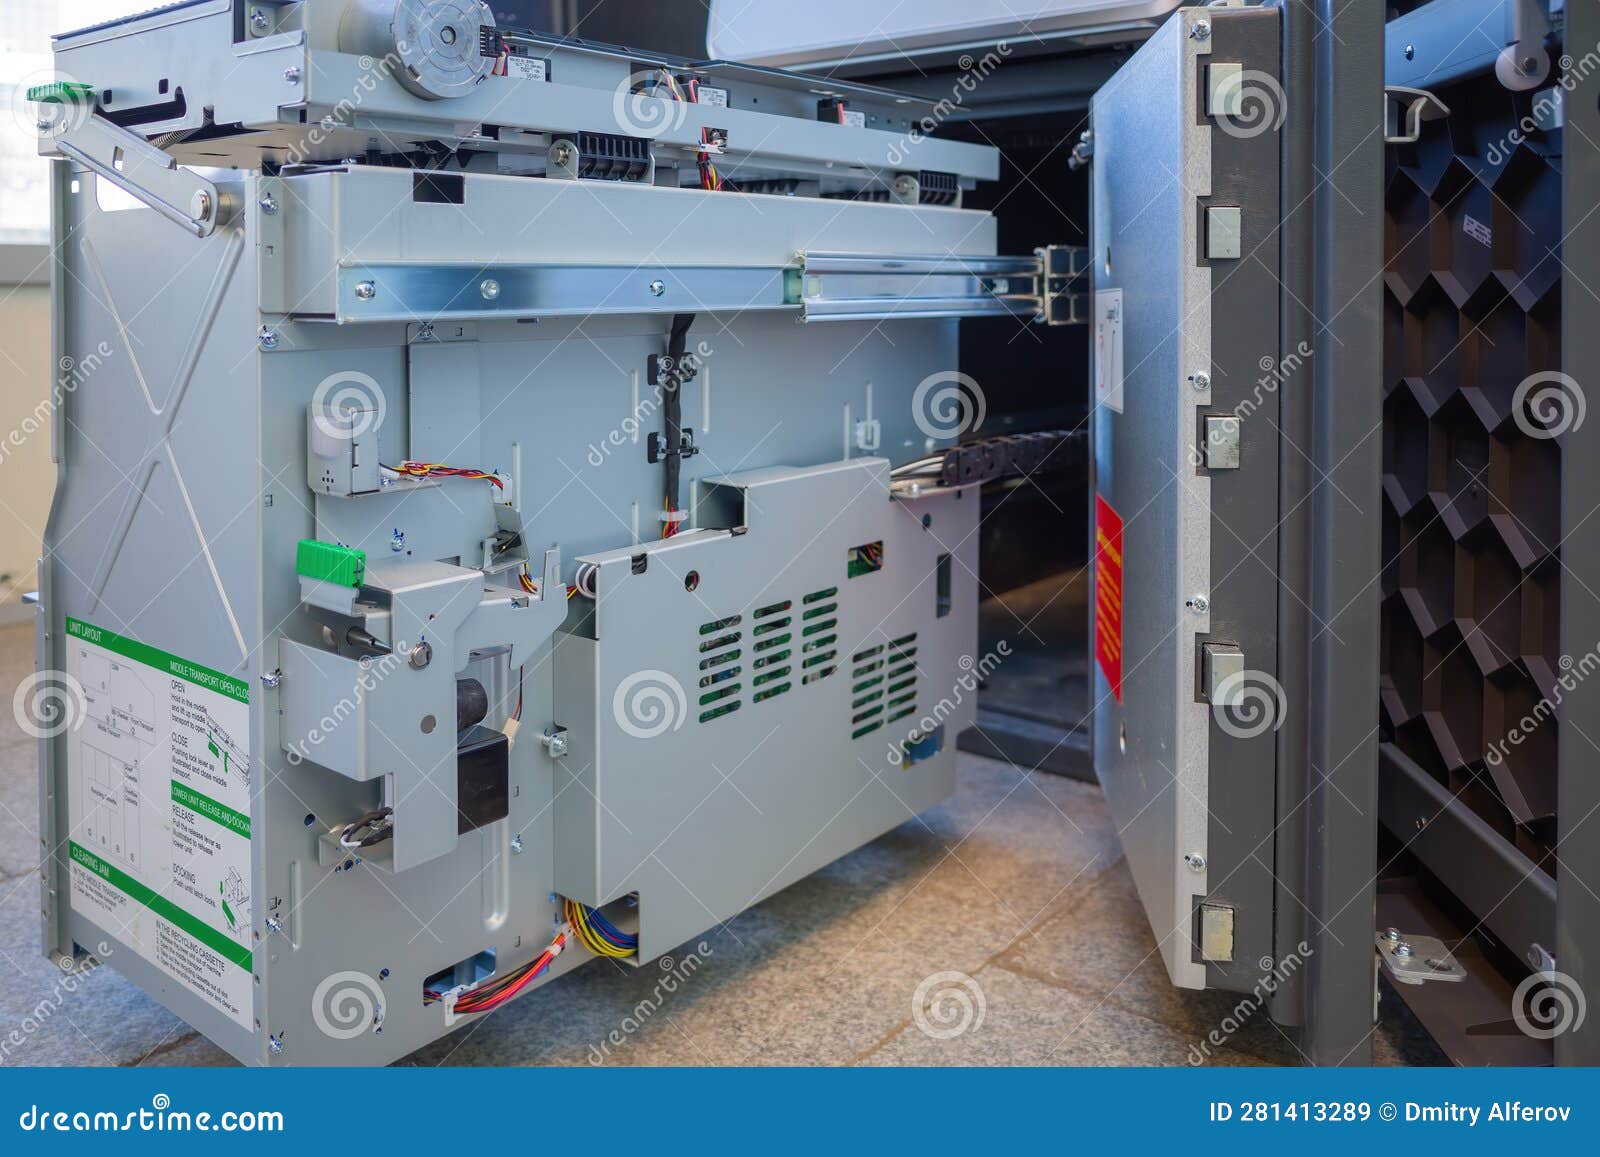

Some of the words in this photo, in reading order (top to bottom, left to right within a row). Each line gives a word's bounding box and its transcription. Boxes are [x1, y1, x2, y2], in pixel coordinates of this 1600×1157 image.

[69, 620, 80, 635] UNIT
[81, 624, 101, 642] LAYOUT
[170, 660, 188, 677] MIDDLE
[189, 667, 218, 688] TRANSPORT
[219, 678, 234, 694] OPEN
[171, 679, 184, 693] OPEN
[171, 730, 187, 748] CLOSE
[172, 804, 194, 825] RELEASE
[199, 798, 221, 819] RELEASE
[221, 809, 232, 825] AND
[72, 845, 98, 872] CLEARING
[99, 861, 109, 879] JAM
[173, 862, 195, 885] DOCKING
[171, 928, 197, 954] RECYCLING
[198, 945, 224, 972] CASSETTE
